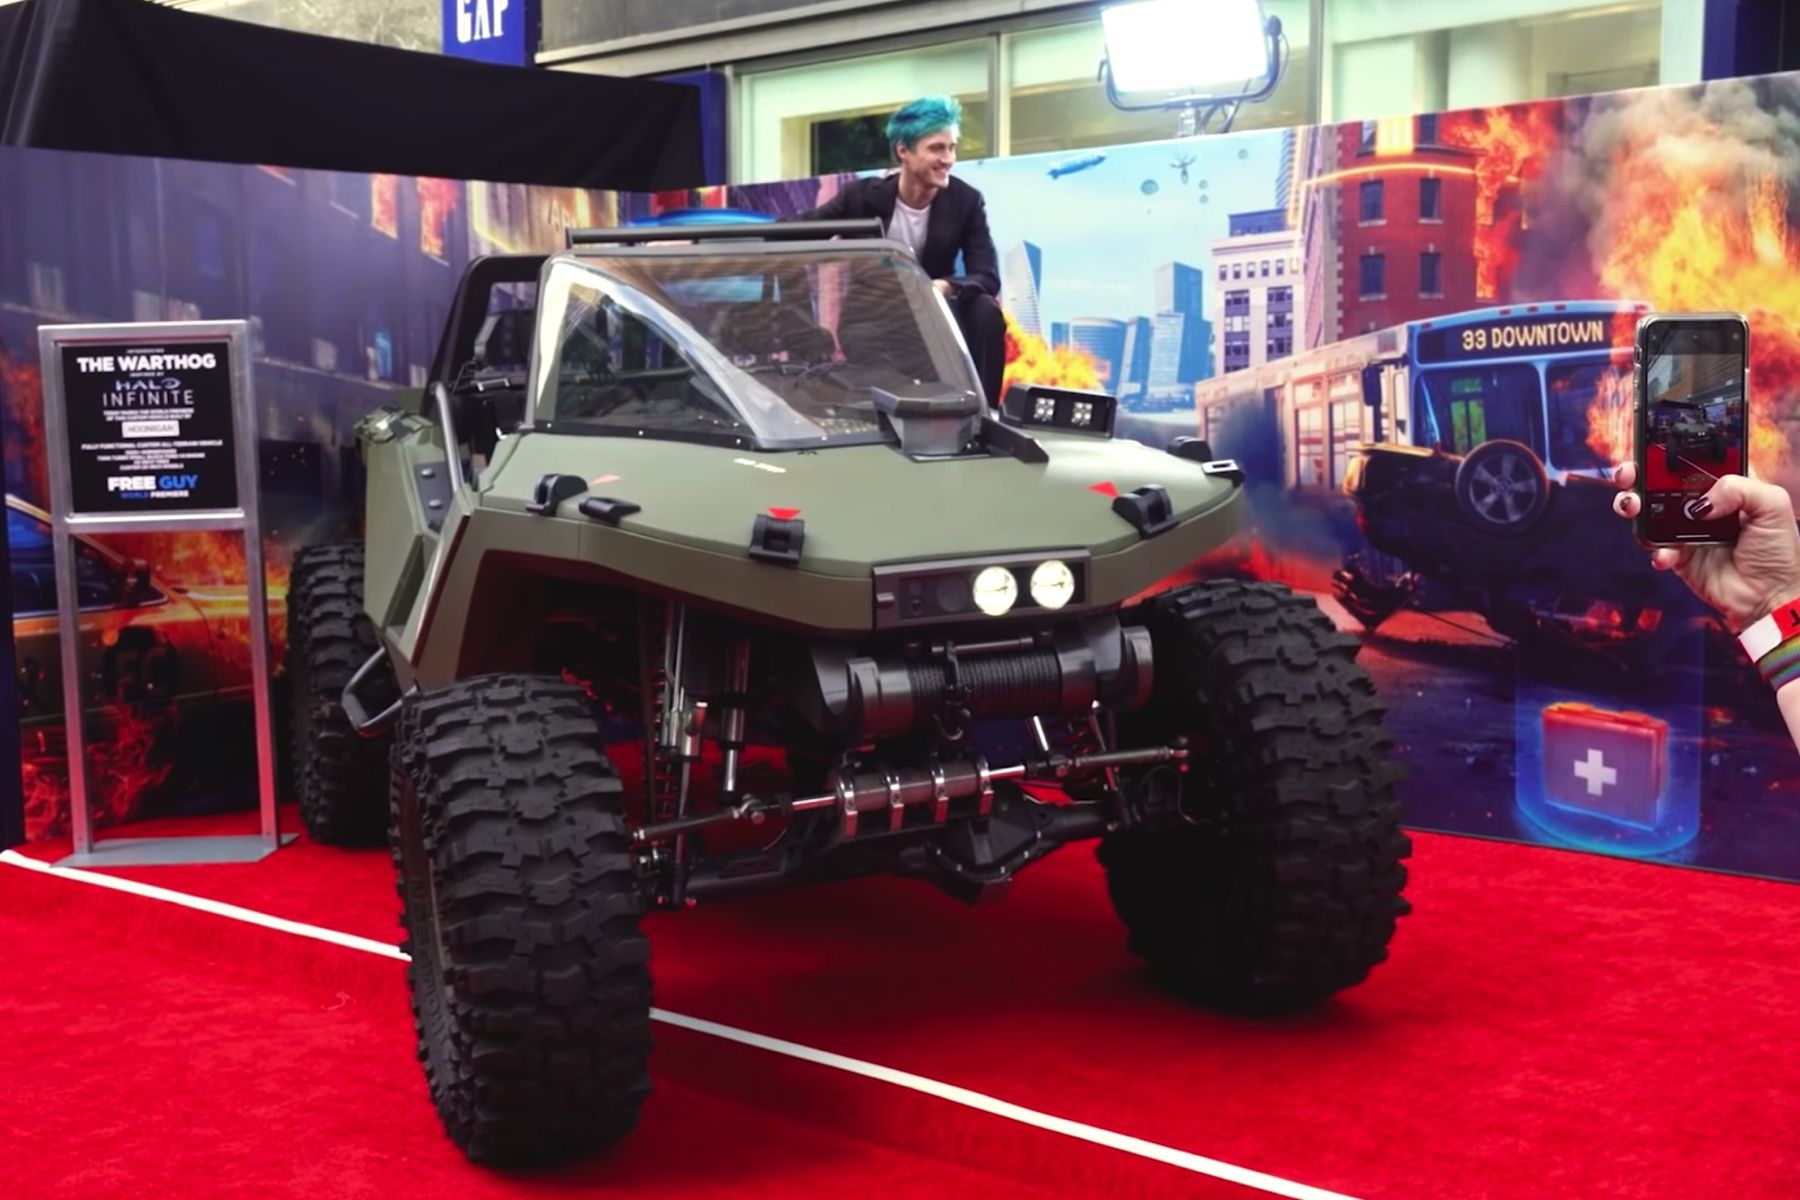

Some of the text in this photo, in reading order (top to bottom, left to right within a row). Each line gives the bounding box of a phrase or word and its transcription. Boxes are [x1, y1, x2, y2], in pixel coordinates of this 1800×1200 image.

[457, 0, 509, 43] GAP
[1462, 320, 1604, 350] 33 DOWNTOWN
[77, 353, 216, 373] THE WARTHOG
[116, 378, 181, 391] HALO
[103, 389, 194, 407] INFINITE
[108, 474, 198, 491] FREE GUY
[150, 490, 189, 498] PREMIERE
